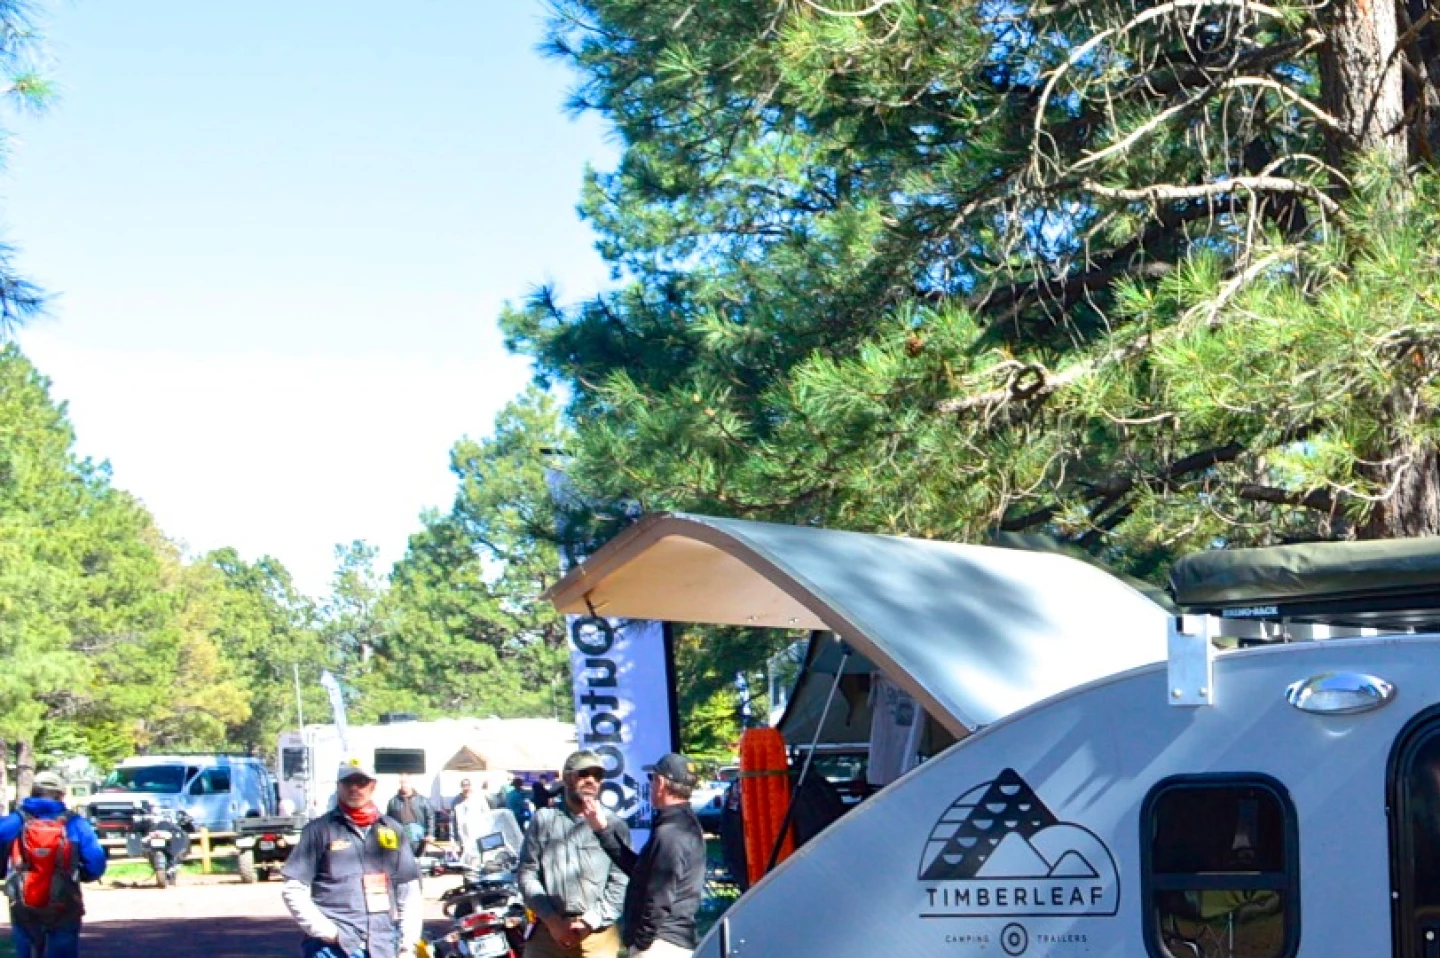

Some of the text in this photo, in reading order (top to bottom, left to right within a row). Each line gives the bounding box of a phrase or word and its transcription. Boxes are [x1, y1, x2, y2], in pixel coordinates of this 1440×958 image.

[926, 886, 1104, 908] TIMBERLEAF
[945, 933, 1087, 943] CAMPING TRAILERS
